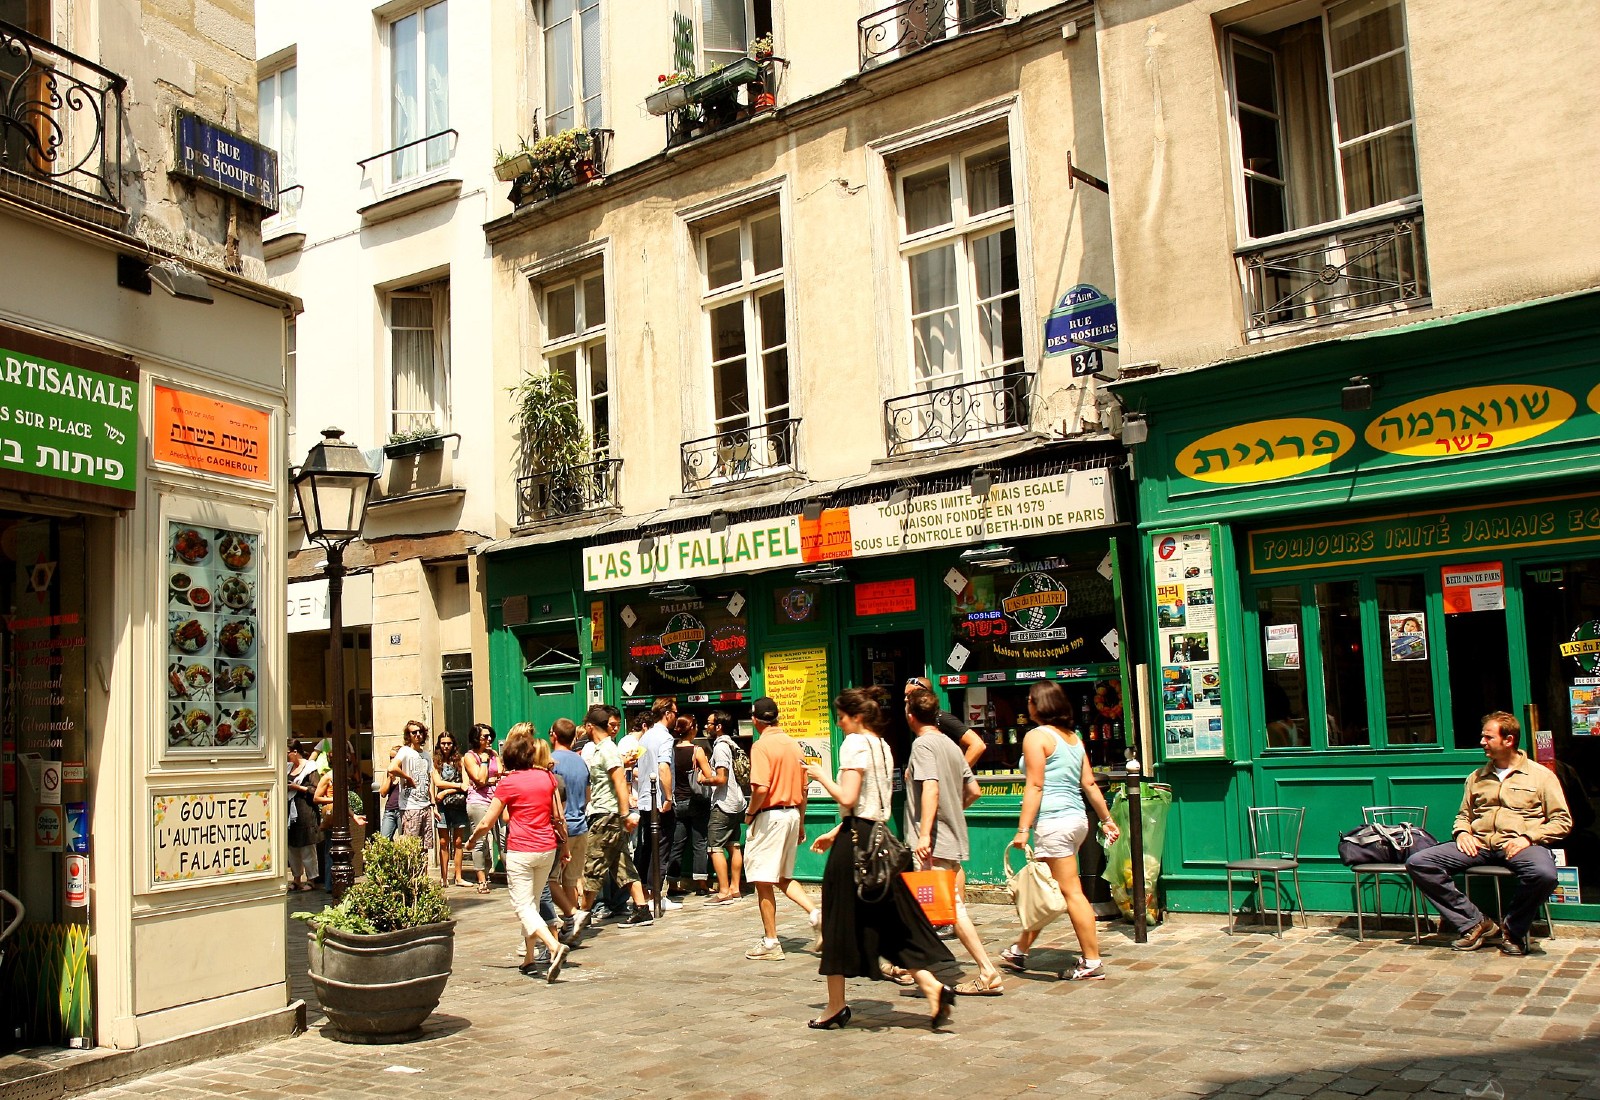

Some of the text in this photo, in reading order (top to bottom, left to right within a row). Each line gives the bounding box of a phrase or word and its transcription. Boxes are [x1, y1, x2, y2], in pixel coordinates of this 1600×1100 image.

[216, 139, 240, 161] RUE
[186, 146, 270, 193] DES ÉCOUFFES
[1069, 315, 1092, 329] RUE
[1047, 323, 1117, 348] DES ROSIERS
[1075, 351, 1098, 373] 34
[15, 409, 44, 428] SUR
[49, 416, 92, 438] PLACE
[1379, 388, 1551, 444] שווארמה
[104, 422, 126, 445] כשר
[170, 423, 258, 457] תעודת כשרות
[1435, 431, 1494, 455] כשר
[36, 445, 124, 480] פיתות
[1193, 428, 1341, 475] פרגית
[206, 456, 258, 474] CACHEROUT
[878, 479, 1065, 519] TOUJOURS IMITE JAMAIS EGALE
[899, 500, 1046, 531] MAISON FONDEE EN 1979
[854, 507, 1106, 551] SOUS LE CONTROLE DU BETH-DIN DE PARIS
[1263, 530, 1374, 561] TOUJOURS
[1385, 514, 1451, 547] IMITÉ
[1462, 511, 1555, 543] JAMAIS
[587, 525, 799, 582] L'AS DU FALLAFEL
[821, 549, 852, 560] CACHEROUT
[1003, 558, 1067, 574] SCHAWARMA
[1475, 573, 1483, 582] DE
[1484, 572, 1500, 581] PARIS
[1006, 600, 1020, 610] L'AS
[1030, 594, 1065, 605] FALLAFEL
[1157, 584, 1179, 598] 파리
[660, 601, 705, 614] FALLAFEL
[961, 618, 1009, 637] כשר
[993, 643, 1020, 658] Maison
[1046, 644, 1069, 658] depuis
[1070, 637, 1084, 649] 1979
[1562, 643, 1580, 655] L'AS
[1582, 642, 1593, 652] du
[985, 673, 998, 681] USA
[21, 716, 75, 731] Citronnade
[180, 799, 248, 821] GOUTEZ
[159, 821, 267, 848] L'AUTHENTIQUE
[180, 846, 250, 873] FALAFEL
